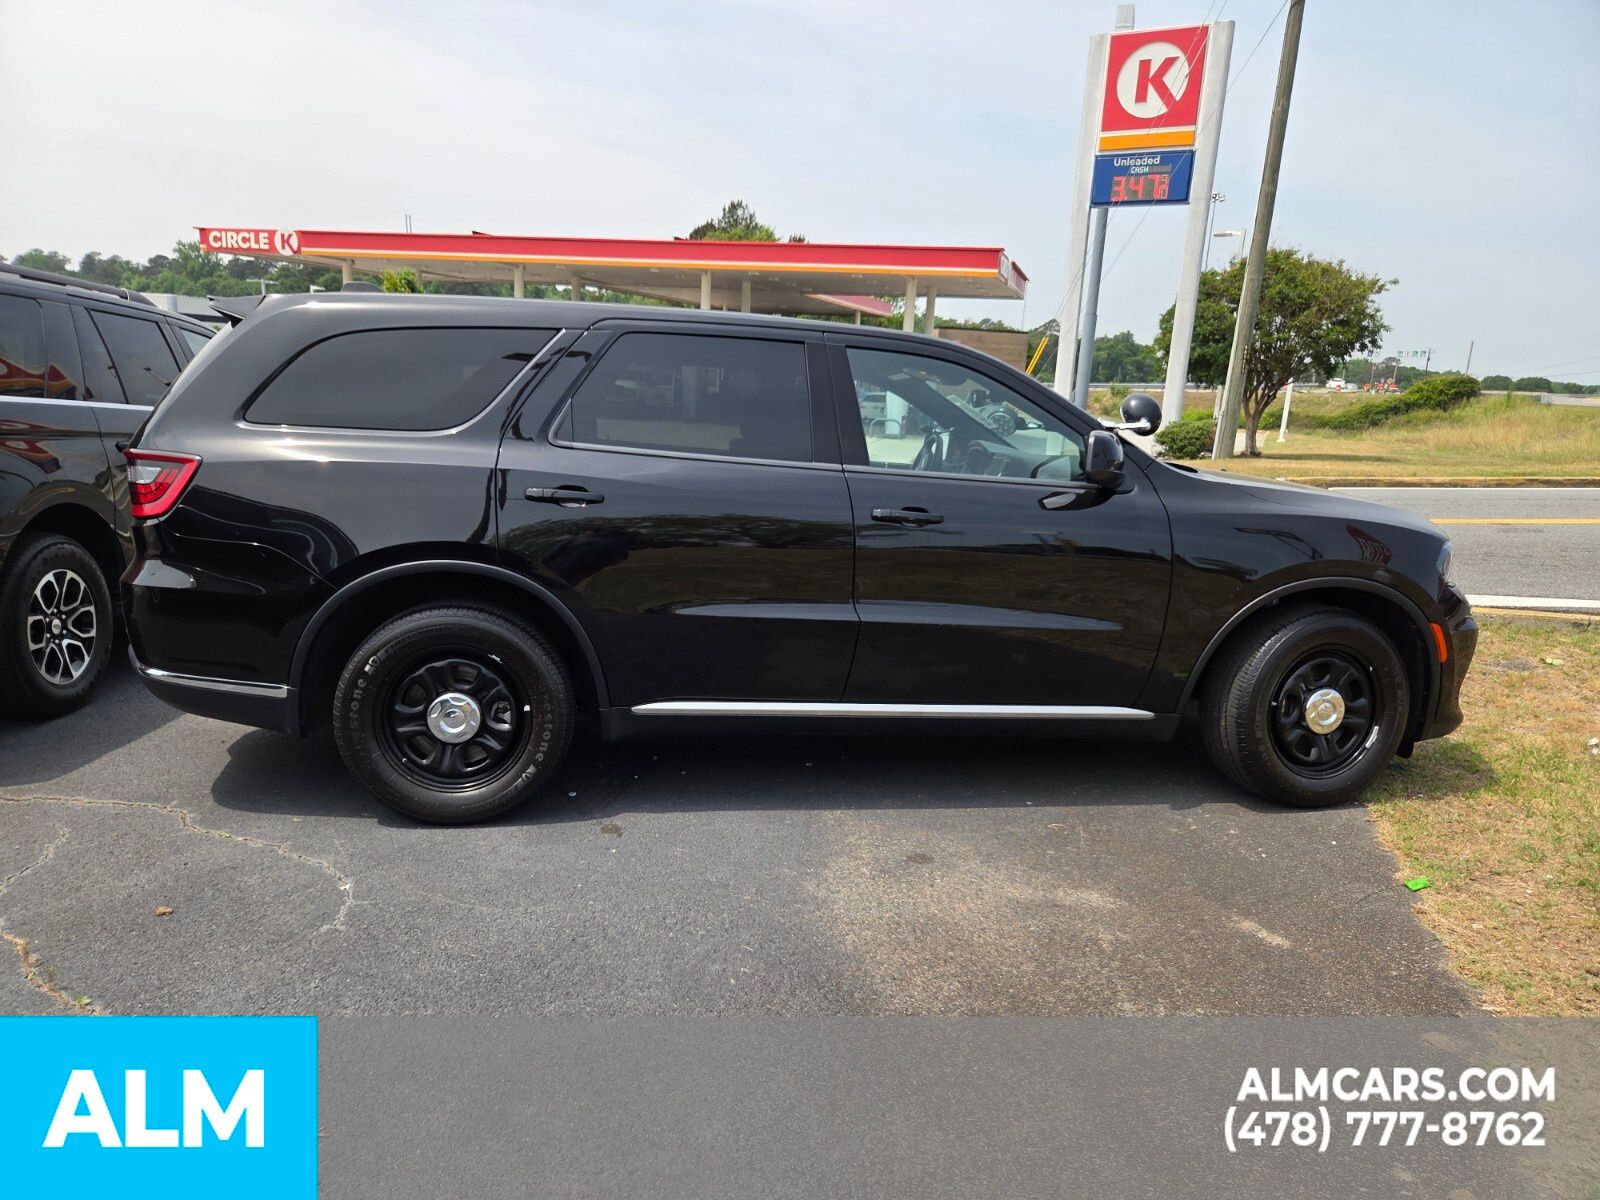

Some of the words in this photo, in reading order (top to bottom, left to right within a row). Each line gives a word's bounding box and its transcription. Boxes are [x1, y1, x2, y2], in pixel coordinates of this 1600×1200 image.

[1134, 56, 1180, 112] K
[1113, 156, 1160, 167] Unleaded
[1130, 166, 1149, 174] CASH
[208, 231, 270, 250] CIRCLE
[280, 233, 298, 254] K
